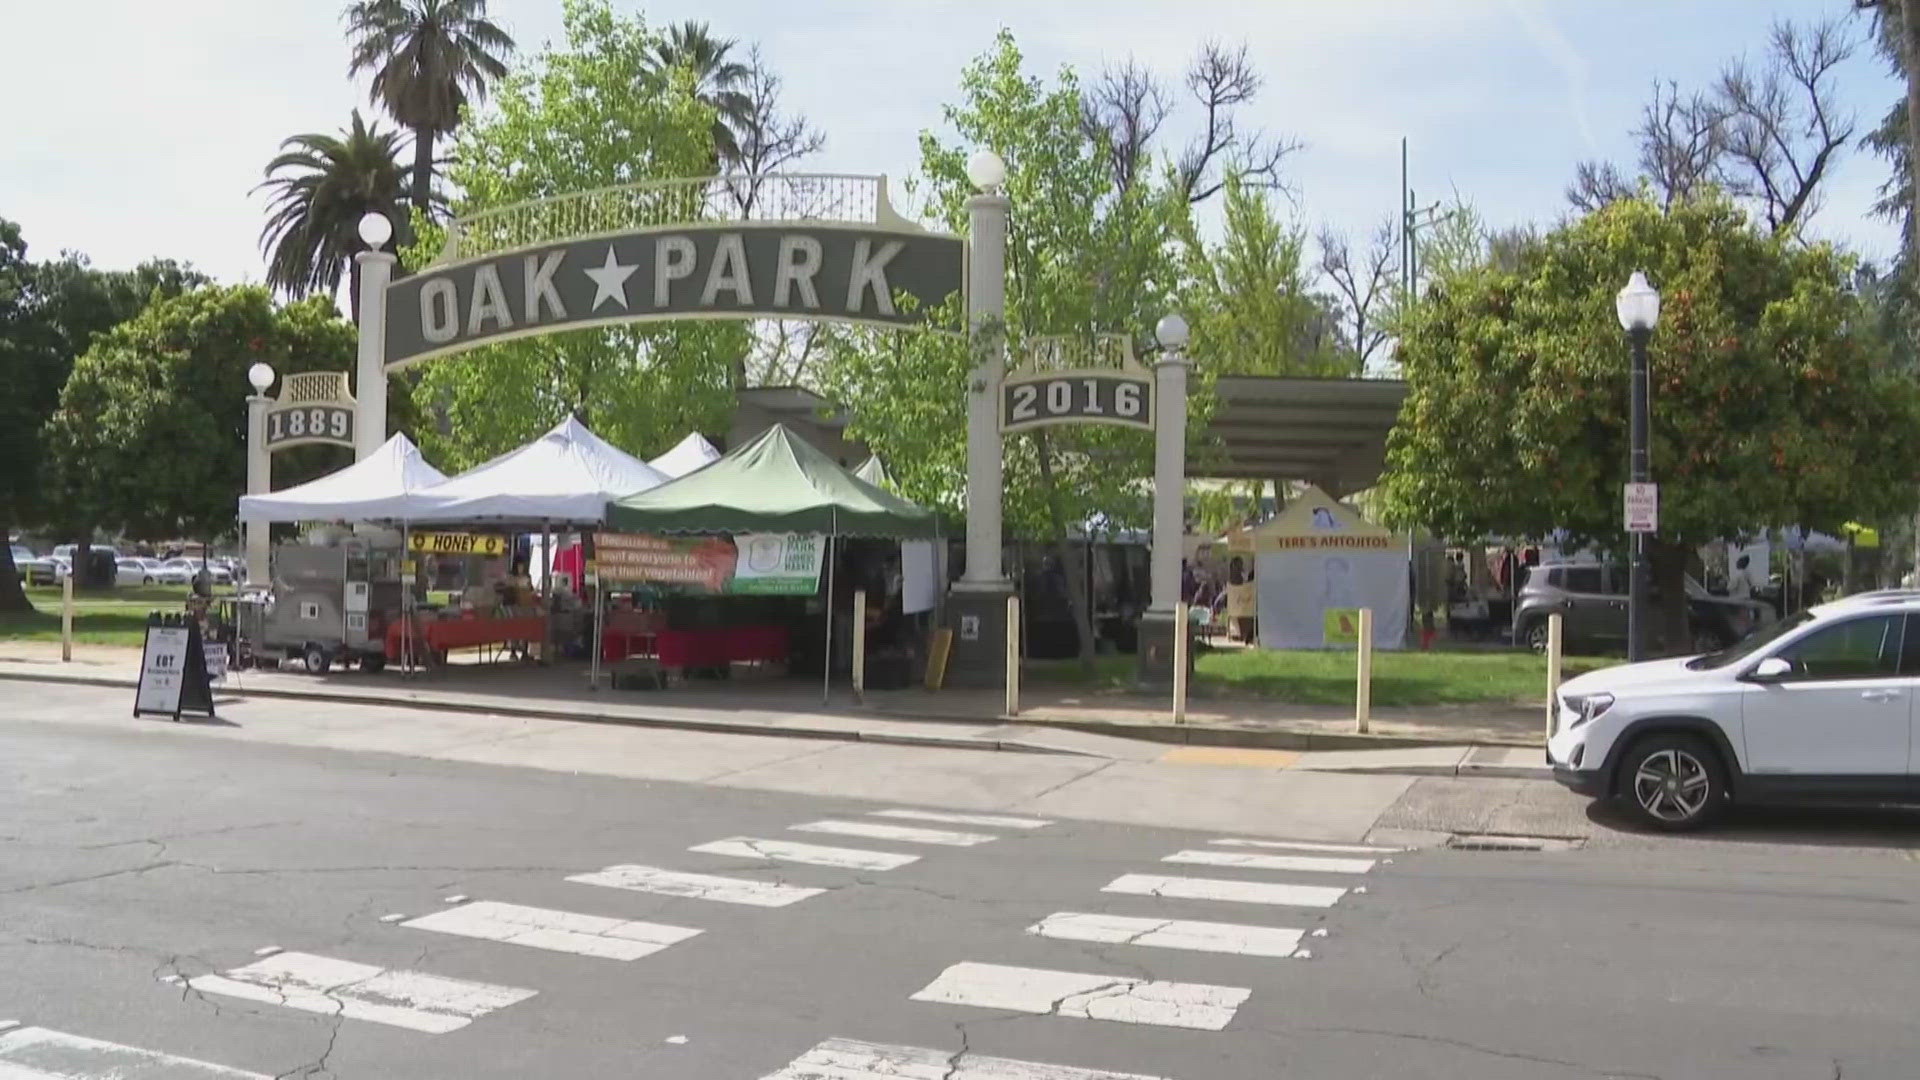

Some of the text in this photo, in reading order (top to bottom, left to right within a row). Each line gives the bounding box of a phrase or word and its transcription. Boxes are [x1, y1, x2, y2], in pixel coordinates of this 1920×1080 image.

[420, 234, 905, 343] OAK PARK
[1012, 380, 1140, 420] 2016
[271, 409, 347, 441] 1889
[433, 535, 478, 551] HONEY
[601, 535, 649, 548] Because
[1279, 536, 1388, 548] TERE'S ANTOJITOS
[602, 551, 697, 565] want everyone to
[618, 565, 642, 578] their
